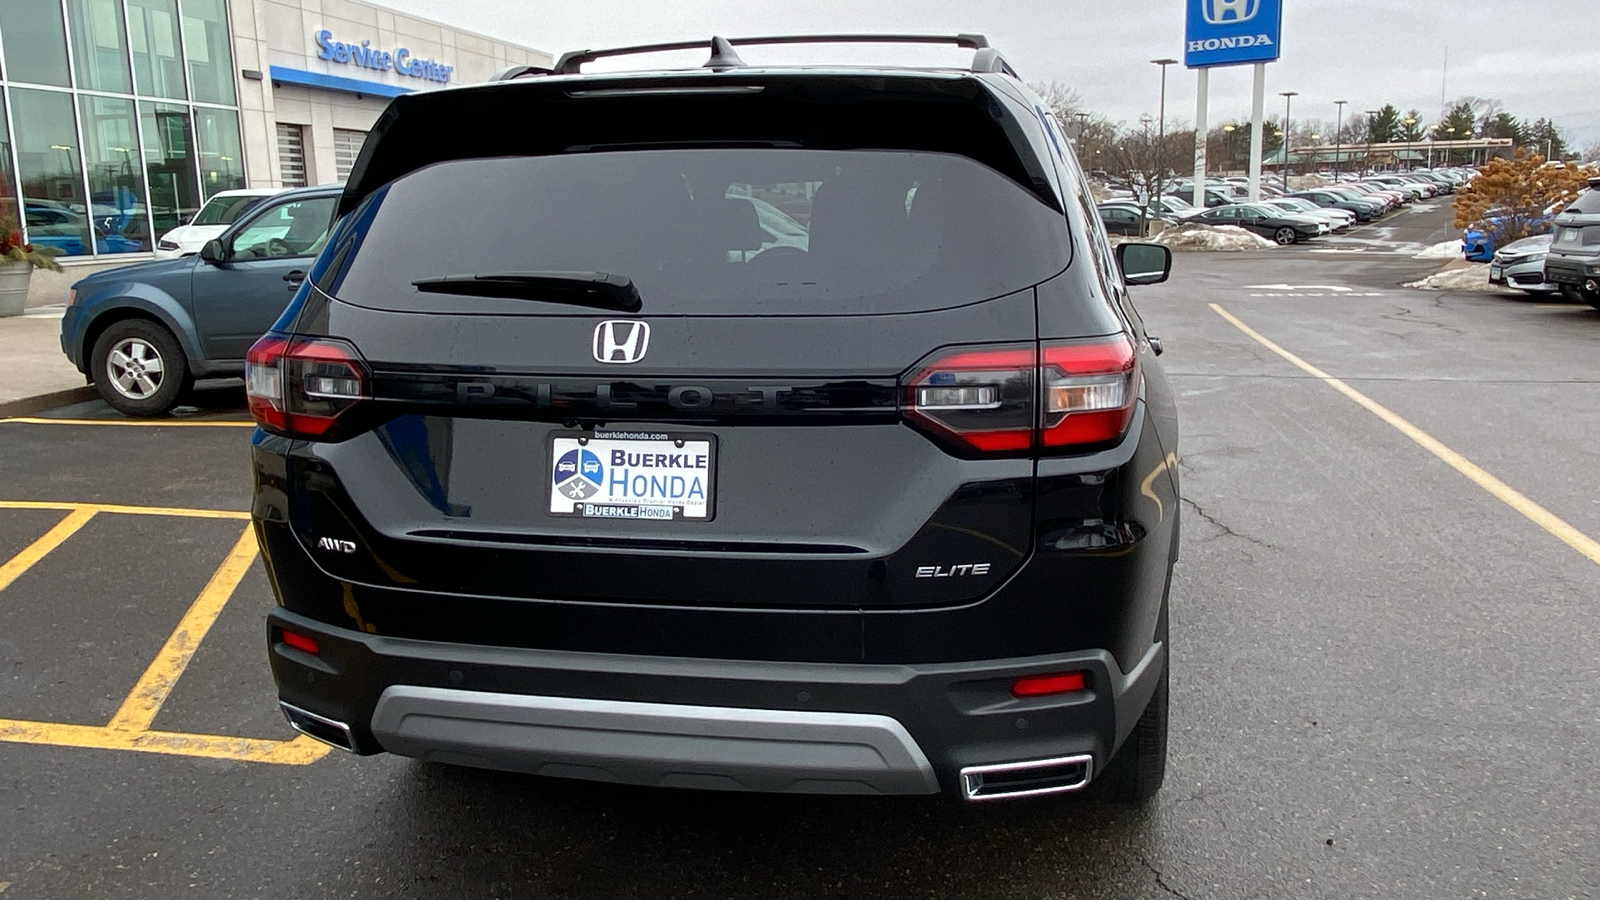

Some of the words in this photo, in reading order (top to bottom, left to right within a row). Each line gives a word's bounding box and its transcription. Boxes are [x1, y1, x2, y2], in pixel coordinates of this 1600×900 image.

[1187, 33, 1274, 53] HONDA
[315, 29, 393, 71] Service
[393, 48, 454, 83] Center
[456, 382, 793, 409] PILOT
[594, 431, 669, 440] buerklehonda.com
[610, 449, 707, 469] BUERKLE
[608, 468, 705, 500] HONDA
[318, 537, 356, 553] AWD
[915, 562, 991, 578] ELITE
